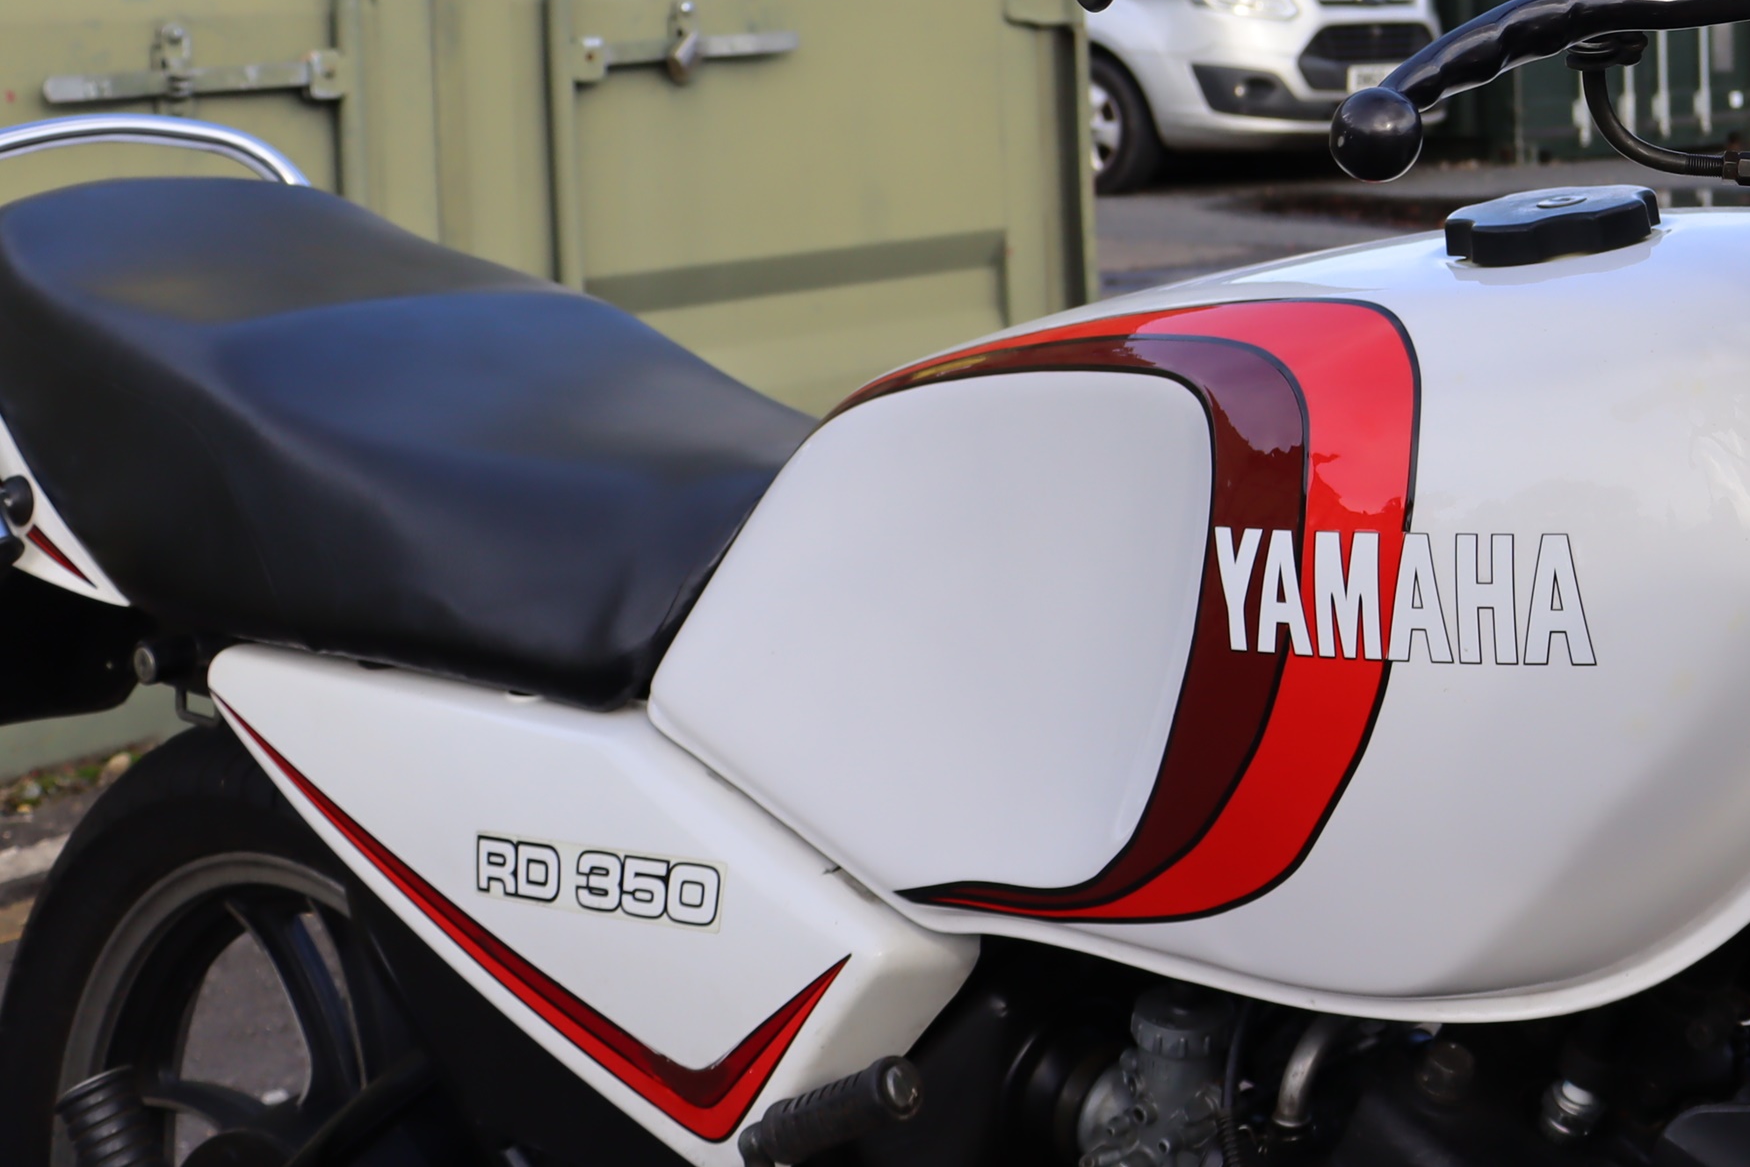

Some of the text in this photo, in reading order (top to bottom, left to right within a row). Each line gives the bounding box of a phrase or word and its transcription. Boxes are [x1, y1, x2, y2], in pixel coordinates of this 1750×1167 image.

[1213, 526, 1597, 666] YAMAHA
[477, 835, 721, 926] RD 350
